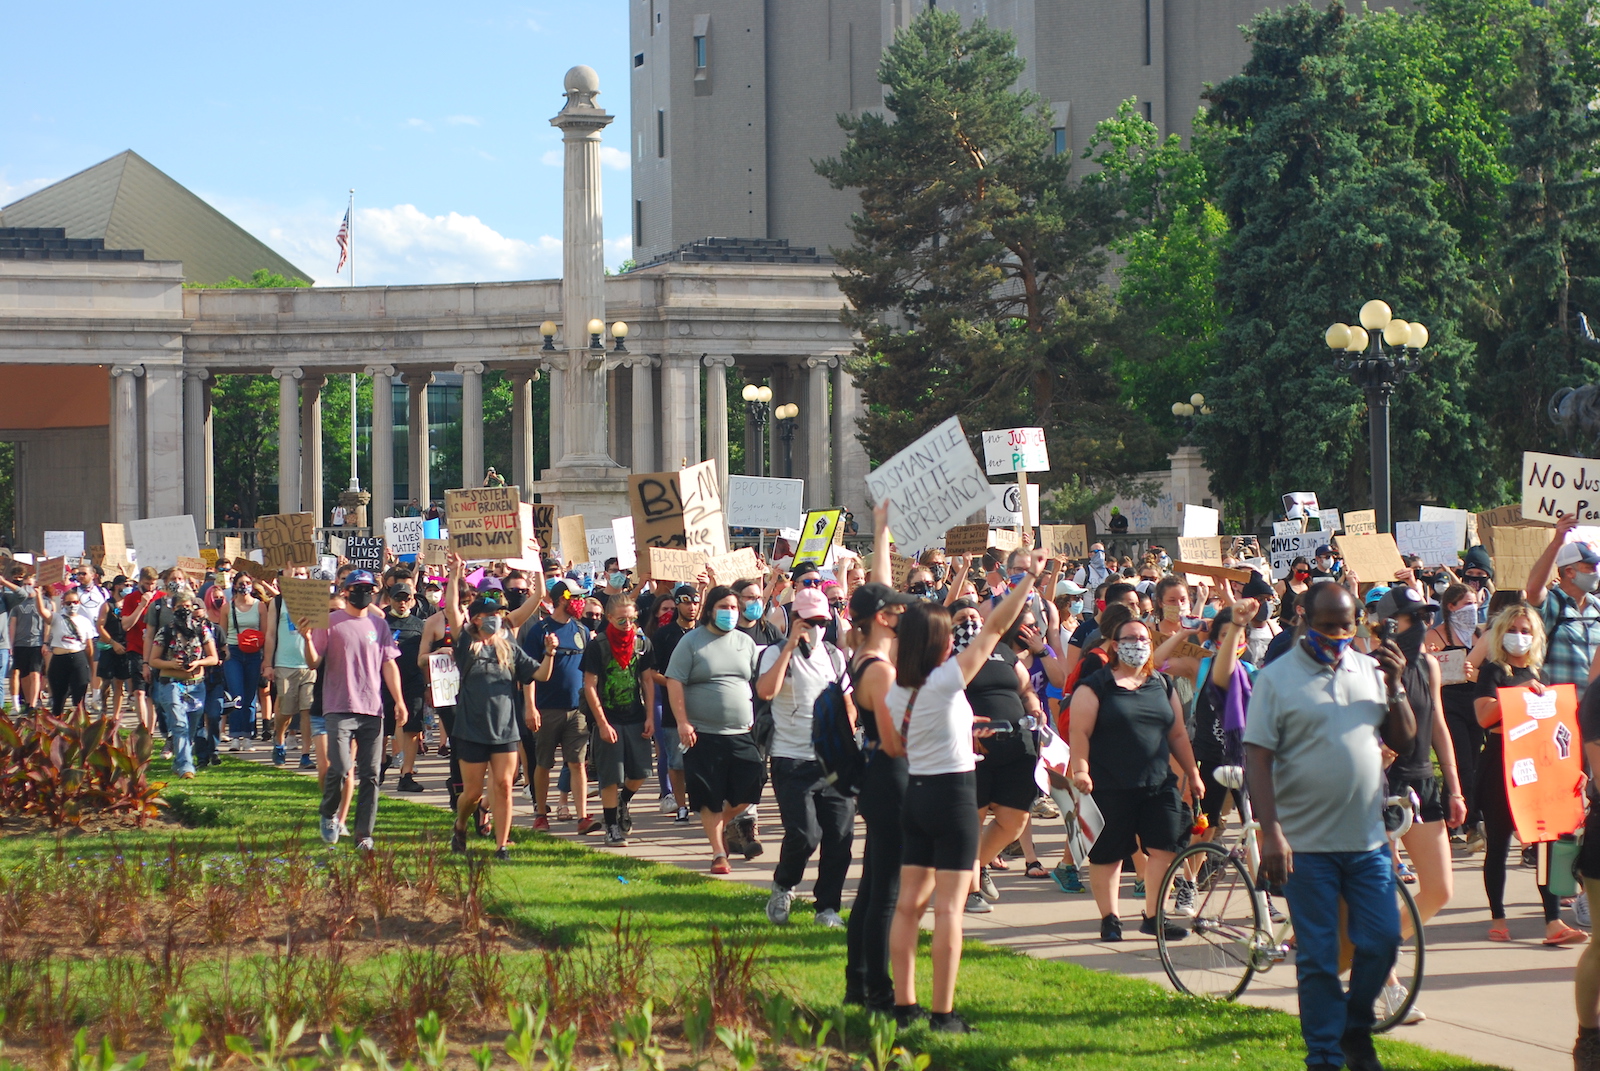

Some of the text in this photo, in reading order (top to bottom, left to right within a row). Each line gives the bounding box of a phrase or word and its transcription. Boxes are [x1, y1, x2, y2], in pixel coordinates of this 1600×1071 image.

[871, 424, 963, 499] DISMANTLE
[638, 466, 721, 516] BLM
[890, 460, 956, 515] WHITE
[454, 488, 508, 502] THE SYSTEM
[450, 503, 459, 513] IS
[461, 502, 478, 512] NOT
[891, 468, 985, 546] SUPREMACY
[262, 514, 302, 531] END
[392, 520, 422, 533] BLACK
[454, 512, 519, 530] IT WAS BUILT
[1481, 512, 1498, 529] NO
[1346, 522, 1376, 533] TOGETHER
[1404, 523, 1444, 539] BLACK
[261, 524, 312, 548] POLICE
[398, 532, 420, 542] LIVES
[454, 530, 514, 548] THIS WAY
[1044, 529, 1082, 540] JUSTICE
[348, 536, 382, 547] BLACK
[392, 542, 420, 553] MATTER
[1180, 539, 1210, 549] WHITE
[1411, 537, 1442, 550] LIVES
[350, 548, 380, 558] LIVES
[1051, 540, 1084, 557] NOW
[1182, 550, 1218, 560] SILENCE
[652, 550, 679, 563] BLACK
[348, 559, 380, 570] MATTER
[663, 564, 697, 580] MATTER
